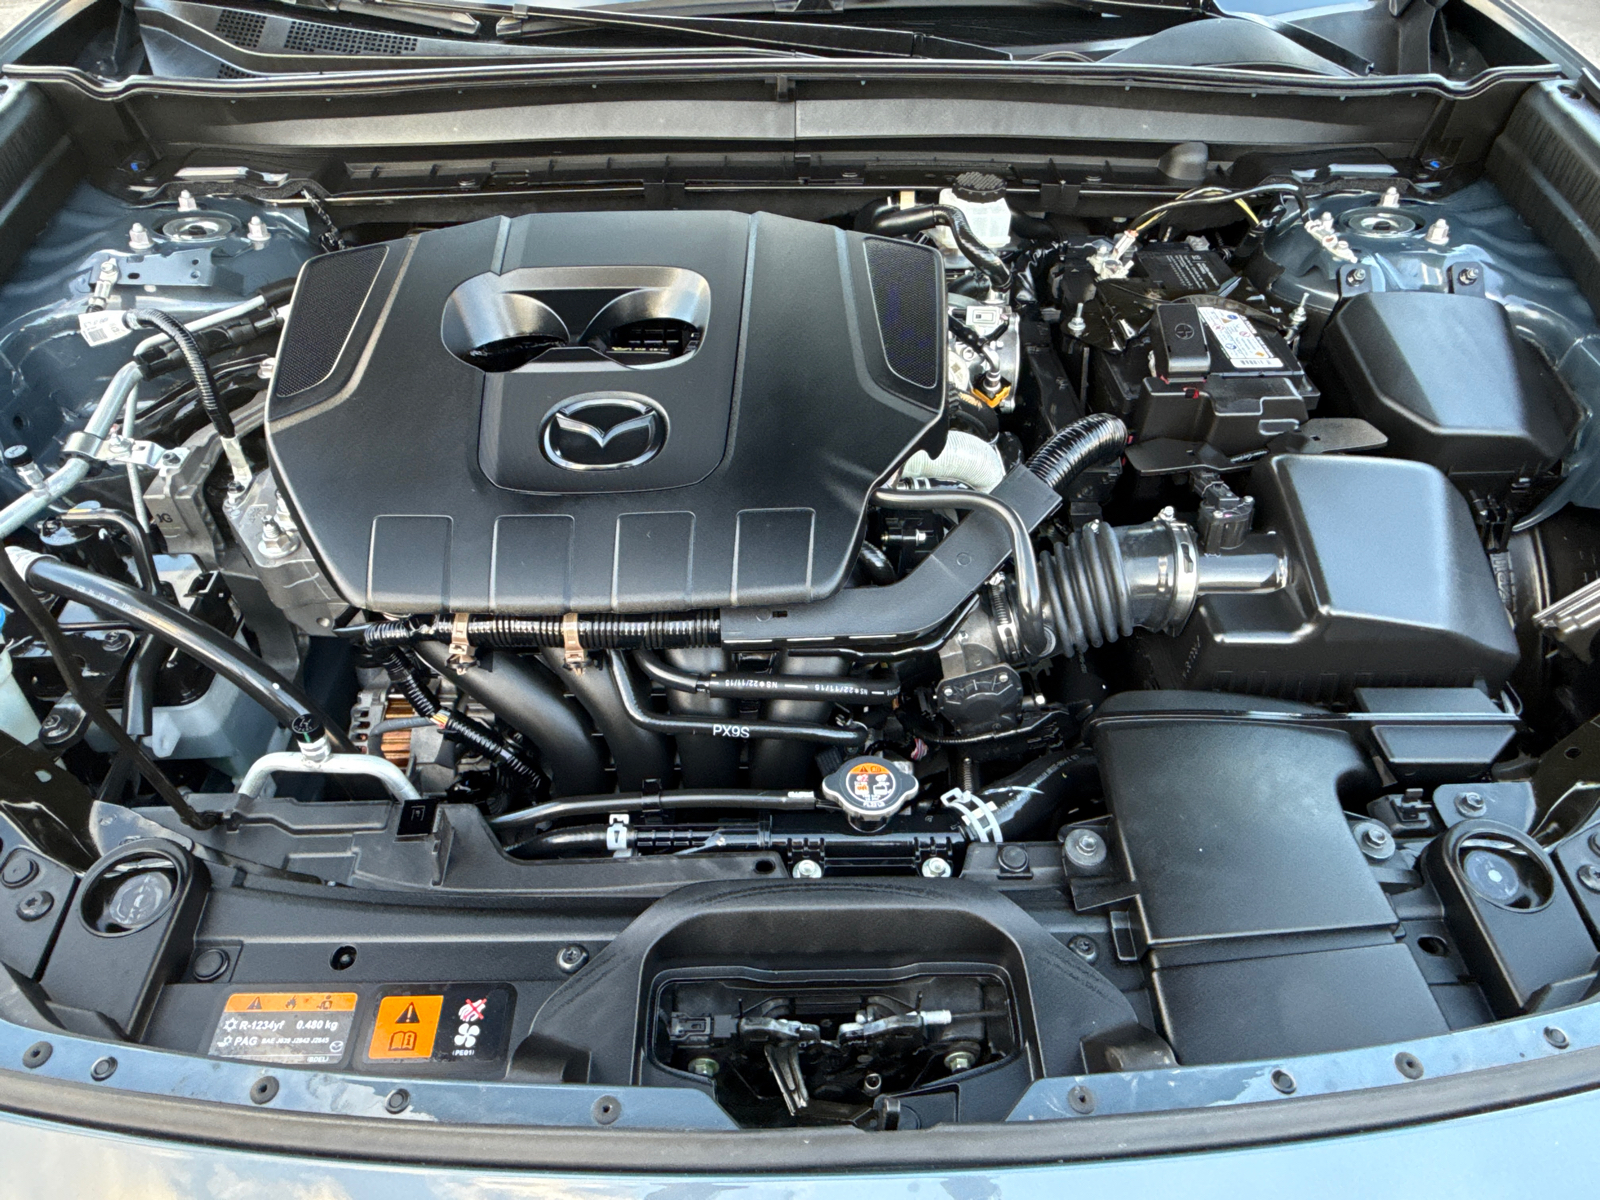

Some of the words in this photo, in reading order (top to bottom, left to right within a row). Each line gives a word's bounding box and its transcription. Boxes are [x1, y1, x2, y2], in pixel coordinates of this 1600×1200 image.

[713, 723, 750, 738] PX9S
[239, 1020, 285, 1032] R-1234yf
[296, 1020, 324, 1030] 0.480
[325, 1020, 339, 1032] kg
[233, 1036, 258, 1047] PAG
